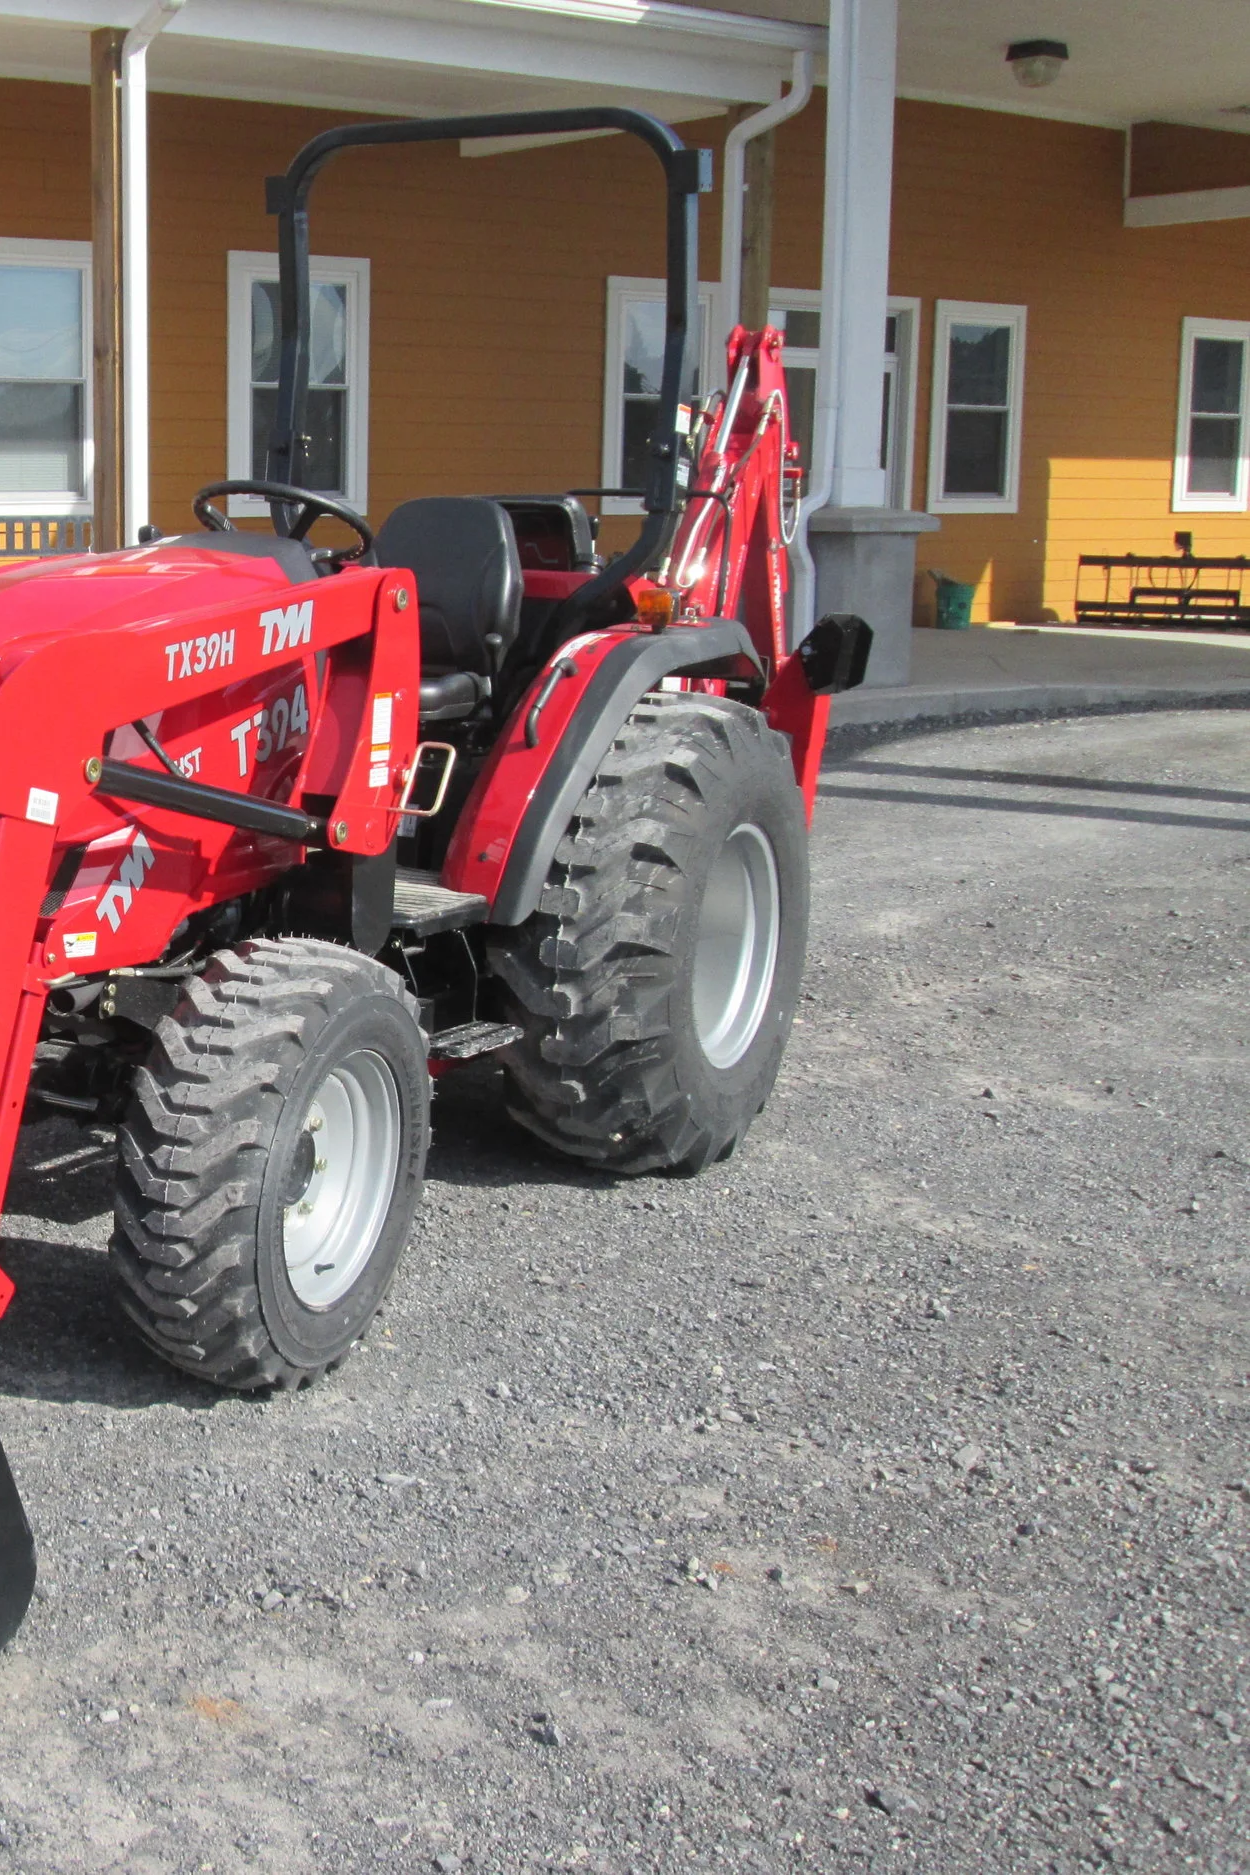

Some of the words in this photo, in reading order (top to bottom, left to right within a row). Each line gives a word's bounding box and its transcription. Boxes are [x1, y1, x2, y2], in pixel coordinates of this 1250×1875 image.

[165, 629, 236, 682] TX39H
[259, 600, 314, 656] TYM
[230, 684, 310, 777] T394
[95, 829, 156, 934] TYM
